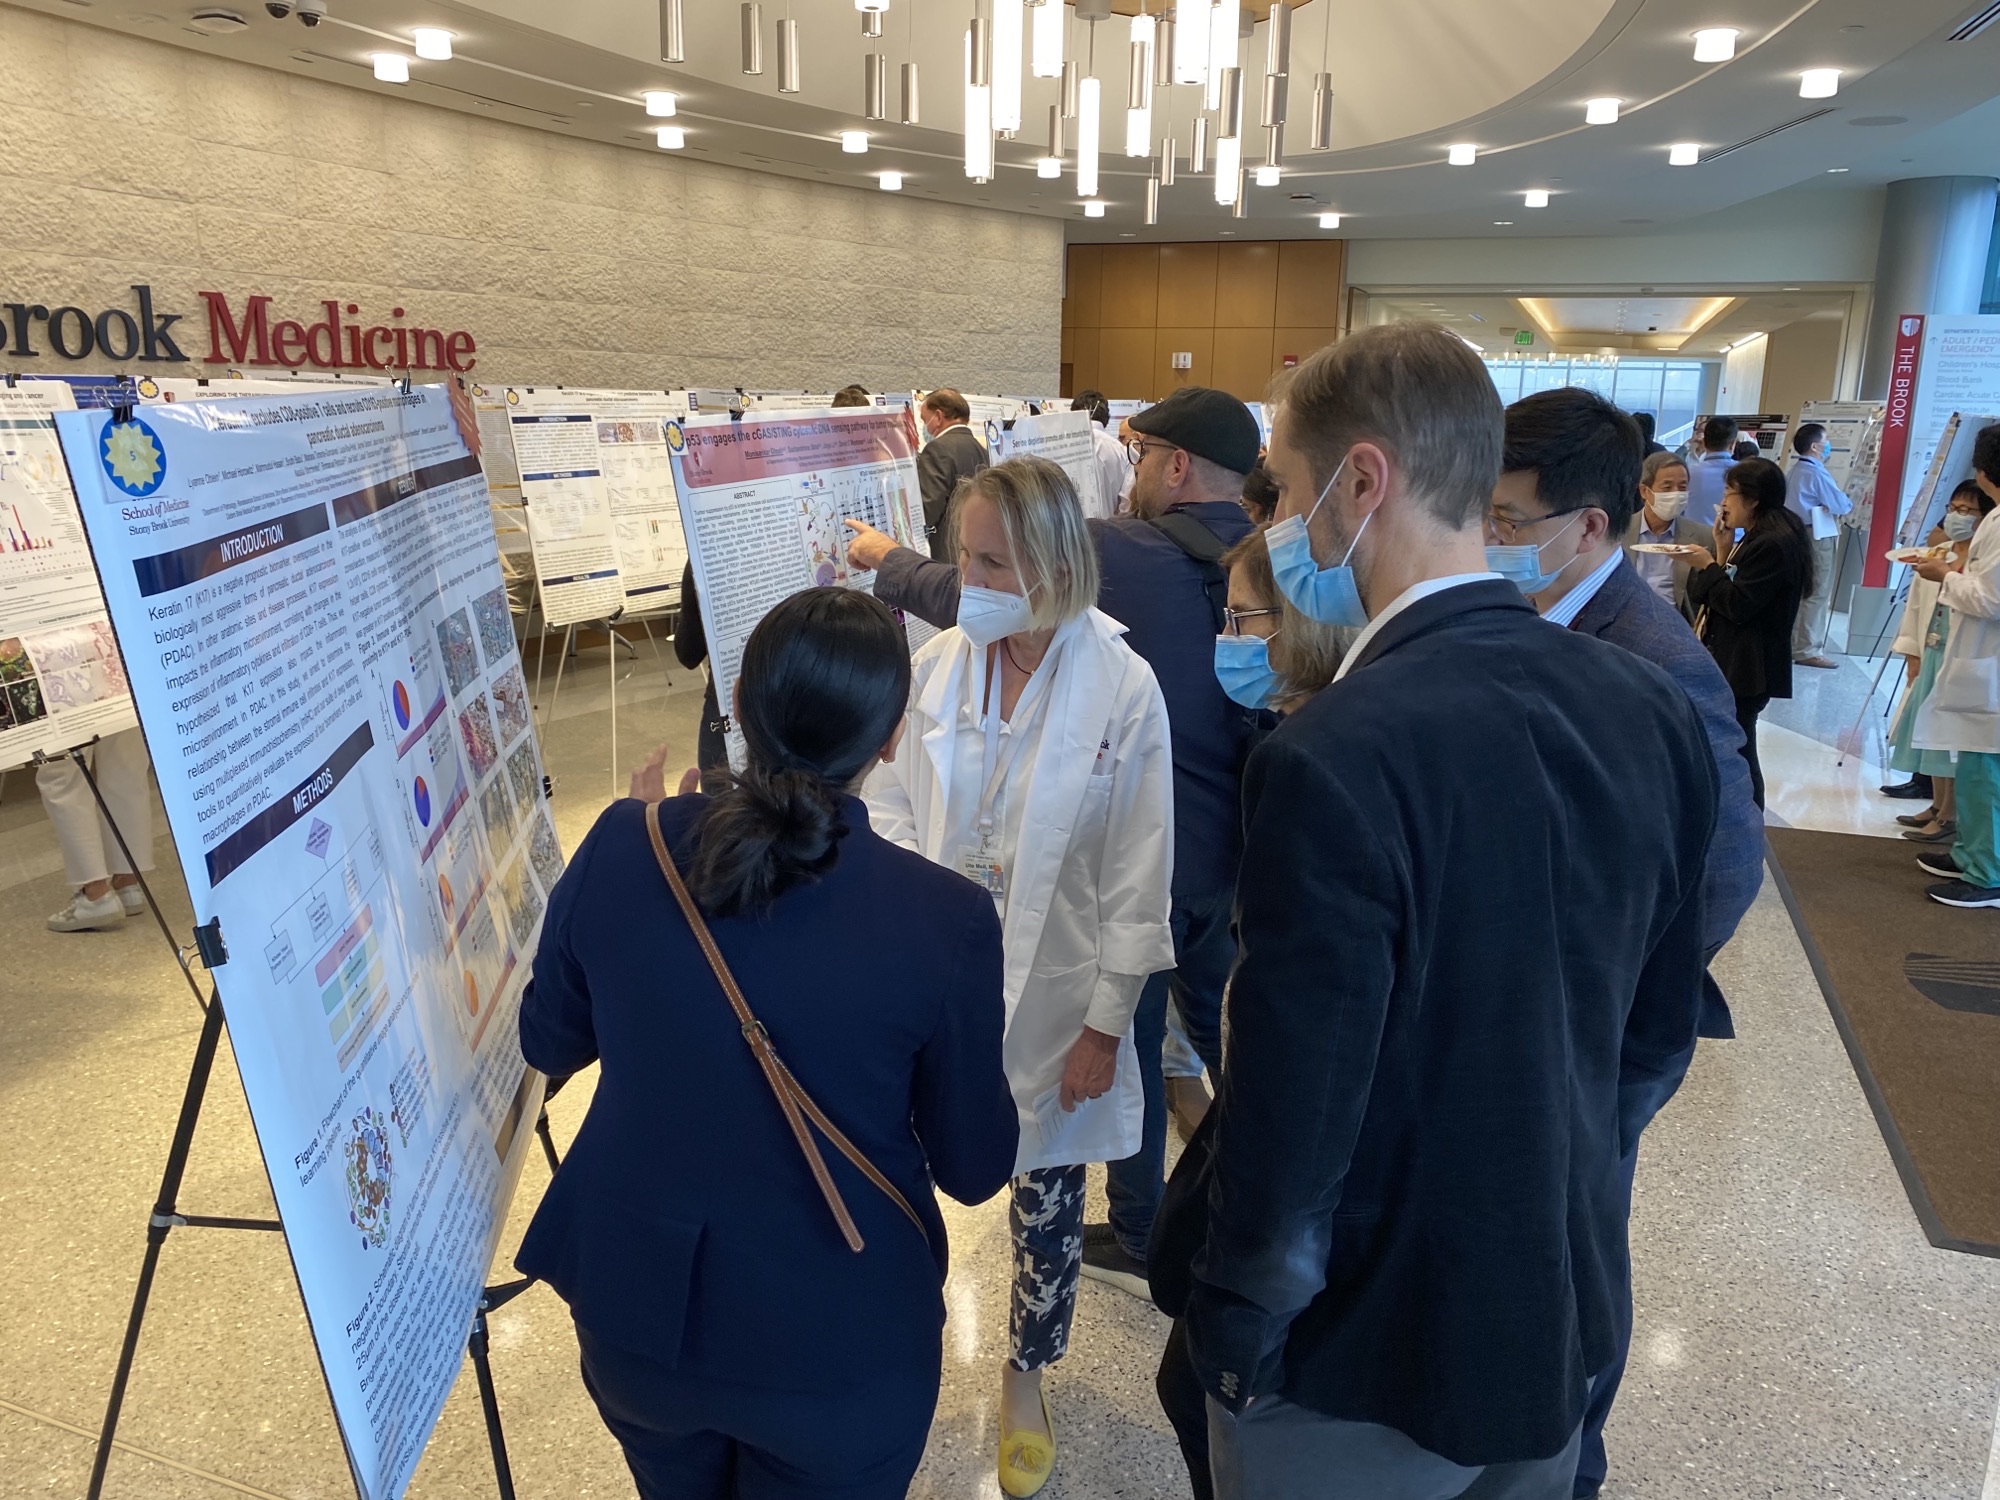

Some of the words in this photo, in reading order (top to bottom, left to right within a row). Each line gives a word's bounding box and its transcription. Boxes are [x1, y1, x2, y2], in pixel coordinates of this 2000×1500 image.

[0, 285, 190, 362] rook
[198, 291, 476, 371] Medicine
[1941, 345, 1995, 353] EMERGENCY
[1942, 336, 1971, 344] ADULT
[1897, 346, 1915, 373] THE
[1938, 360, 1978, 368] Children's
[251, 408, 284, 427] excludes
[322, 401, 338, 417] cells
[335, 400, 347, 415] and
[1890, 379, 1910, 428] BROOK
[130, 451, 136, 461] 5
[306, 426, 336, 448] pancreatic
[335, 423, 352, 440] ductal
[350, 419, 385, 437] adenocarcinoma
[686, 431, 701, 449] p53
[702, 432, 737, 448] engages
[737, 430, 751, 442] the
[752, 425, 793, 442] cGAS/STING
[818, 424, 830, 435] DNA
[831, 422, 850, 435] sensing
[850, 420, 869, 433] pathway
[1012, 439, 1027, 449] Serine
[121, 503, 154, 521] School
[155, 501, 164, 518] of
[164, 498, 190, 513] Medicine
[397, 476, 415, 495] RESULTS
[733, 490, 756, 500] ABSTRACT
[129, 525, 151, 536] Stony
[151, 521, 168, 532] Brook
[168, 515, 190, 528] University
[220, 523, 284, 564] INTRODUCTION
[148, 601, 183, 621] Keratin
[185, 595, 192, 609] 17
[195, 588, 211, 608] (K17)
[223, 576, 244, 593] negative
[245, 564, 268, 585] prognostic
[154, 619, 198, 645] biologically
[201, 611, 214, 627] most
[216, 600, 242, 621] aggressive
[243, 591, 258, 606] forms
[267, 575, 289, 597] pancreatic
[291, 570, 304, 584] ductal
[160, 643, 196, 670] (PDAC).
[205, 633, 218, 648] other
[220, 620, 244, 640] anatomic
[244, 615, 257, 628] sites
[257, 607, 268, 621] and
[268, 600, 285, 615] disease
[165, 669, 199, 690] impacts
[199, 661, 209, 676] the
[209, 645, 243, 670] inflammatory
[171, 686, 210, 712] expression
[210, 679, 216, 693] of
[216, 663, 251, 689] inflammatory
[176, 701, 221, 735] hypothesized
[225, 691, 238, 708] that
[242, 681, 255, 698] K17
[260, 666, 284, 687] expression
[182, 715, 239, 757] microenvironment
[240, 711, 248, 722] in
[249, 697, 269, 717] PDAC.
[187, 748, 227, 780] relationship
[226, 732, 253, 755] between
[253, 725, 263, 739] the
[263, 710, 281, 731] stromal
[281, 699, 300, 719] immune
[192, 781, 215, 802] using
[215, 756, 249, 788] multiplexed
[249, 722, 301, 766] immunohistochemistry
[197, 804, 217, 823] tools
[217, 799, 225, 811] to
[225, 771, 263, 807] quantitatively
[263, 756, 286, 778] evaluate
[285, 749, 294, 762] the
[202, 809, 246, 845] macrophages
[252, 786, 274, 809] PDAC.
[292, 767, 333, 815] METHODS
[294, 1138, 318, 1170] Figure
[321, 1093, 344, 1130] Flowchart
[342, 1083, 349, 1098] of
[347, 1074, 356, 1091] the
[355, 1041, 378, 1080] quantitative
[377, 1024, 388, 1044] image
[387, 1002, 402, 1028] analysis
[299, 1150, 327, 1188] learning
[325, 1122, 342, 1156] pipeline
[345, 1305, 369, 1338] Figure
[374, 1248, 397, 1293] Schematic
[394, 1218, 408, 1250] diagram
[350, 1310, 378, 1354] negative
[396, 1239, 412, 1271] Stromal
[410, 1209, 422, 1240] immune
[379, 1312, 389, 1330] the
[388, 1280, 405, 1315] closest
[403, 1258, 415, 1285] tumor
[359, 1343, 387, 1393] Brightfield
[387, 1302, 409, 1345] multicolor
[408, 1282, 418, 1303] IHC
[417, 1266, 426, 1285] was
[364, 1365, 389, 1412] provided
[370, 1361, 403, 1428] representative
[374, 1414, 389, 1444] Color
[415, 1395, 438, 1445] generated
